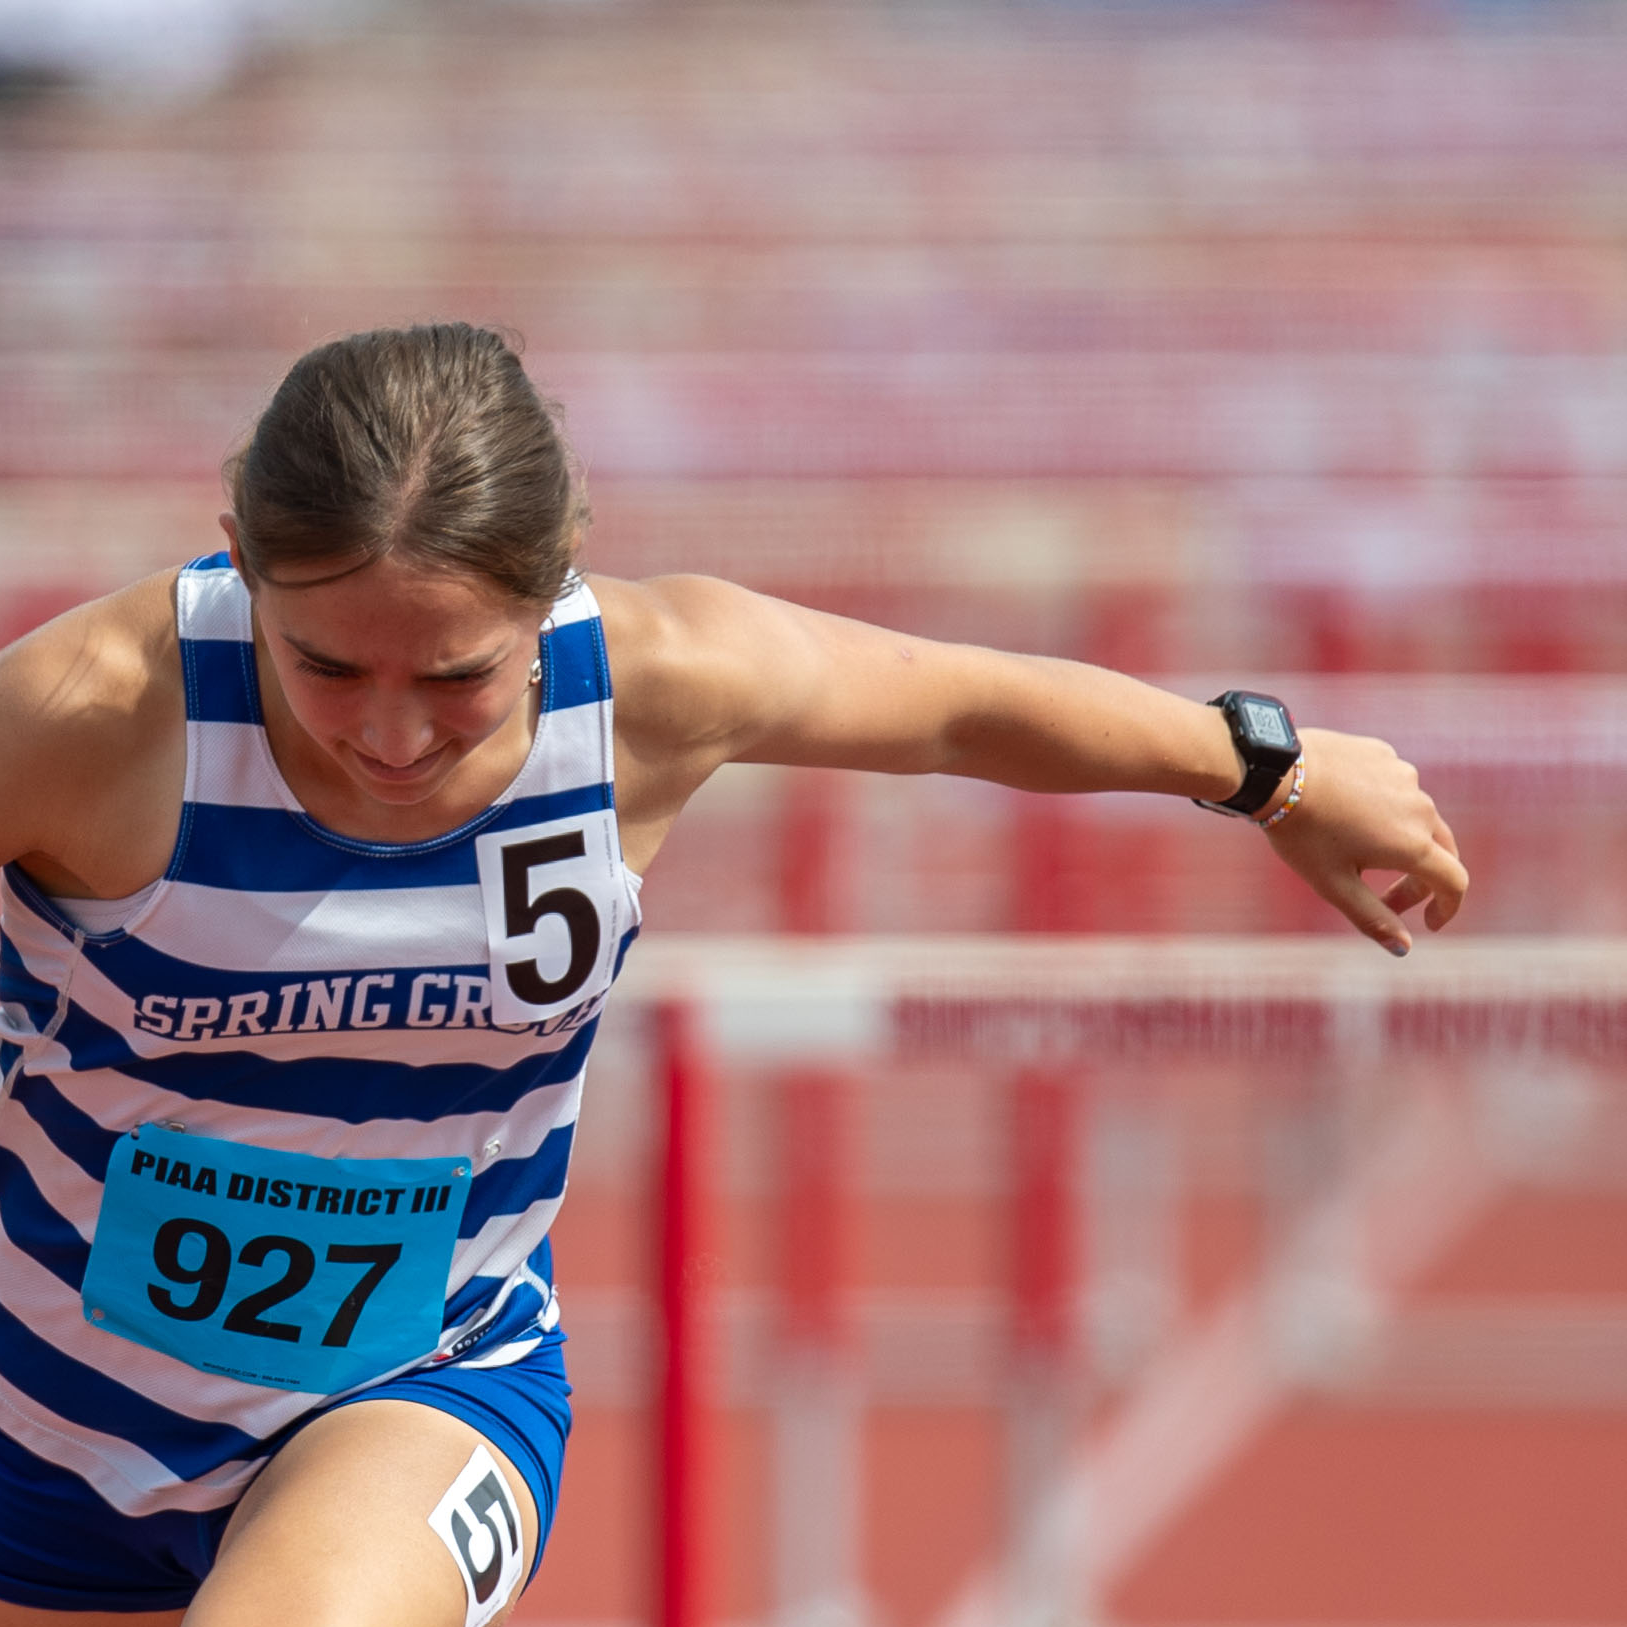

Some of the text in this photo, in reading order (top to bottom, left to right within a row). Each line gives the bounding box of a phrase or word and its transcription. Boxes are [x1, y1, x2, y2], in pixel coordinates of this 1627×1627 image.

[500, 829, 601, 1006] 5
[138, 973, 396, 1041] SPRING
[130, 1148, 452, 1217] PIAA DISTRICT III
[146, 1217, 404, 1349] 927
[450, 1469, 520, 1605] 5
